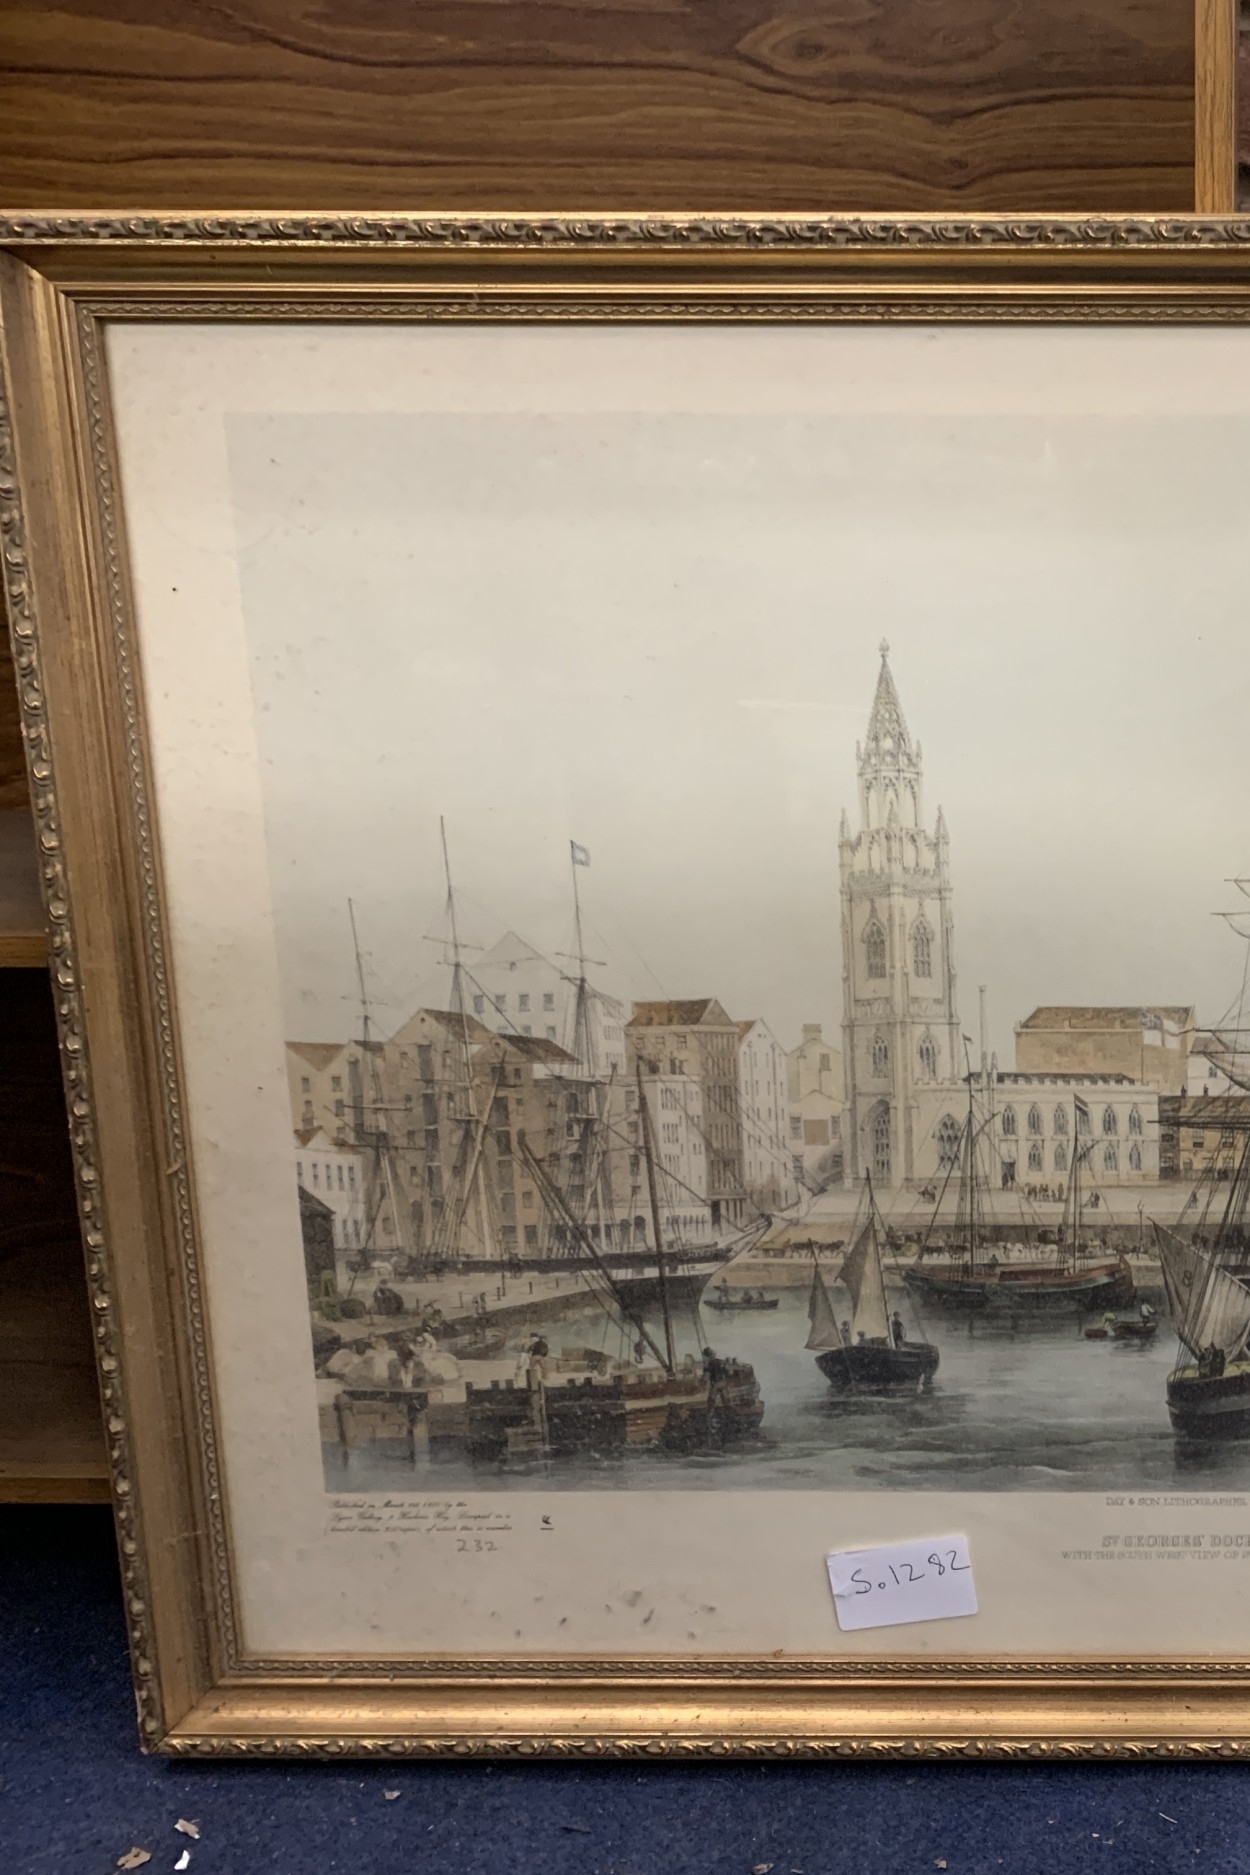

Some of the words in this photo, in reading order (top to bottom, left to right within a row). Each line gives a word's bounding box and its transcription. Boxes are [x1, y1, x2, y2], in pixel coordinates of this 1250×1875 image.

[1105, 1497, 1125, 1506] DAY
[1138, 1497, 1160, 1506] SON
[456, 1539, 498, 1553] 232
[1061, 1550, 1092, 1560] WITH
[1094, 1550, 1115, 1560] THE
[1189, 1550, 1221, 1560] VIEW
